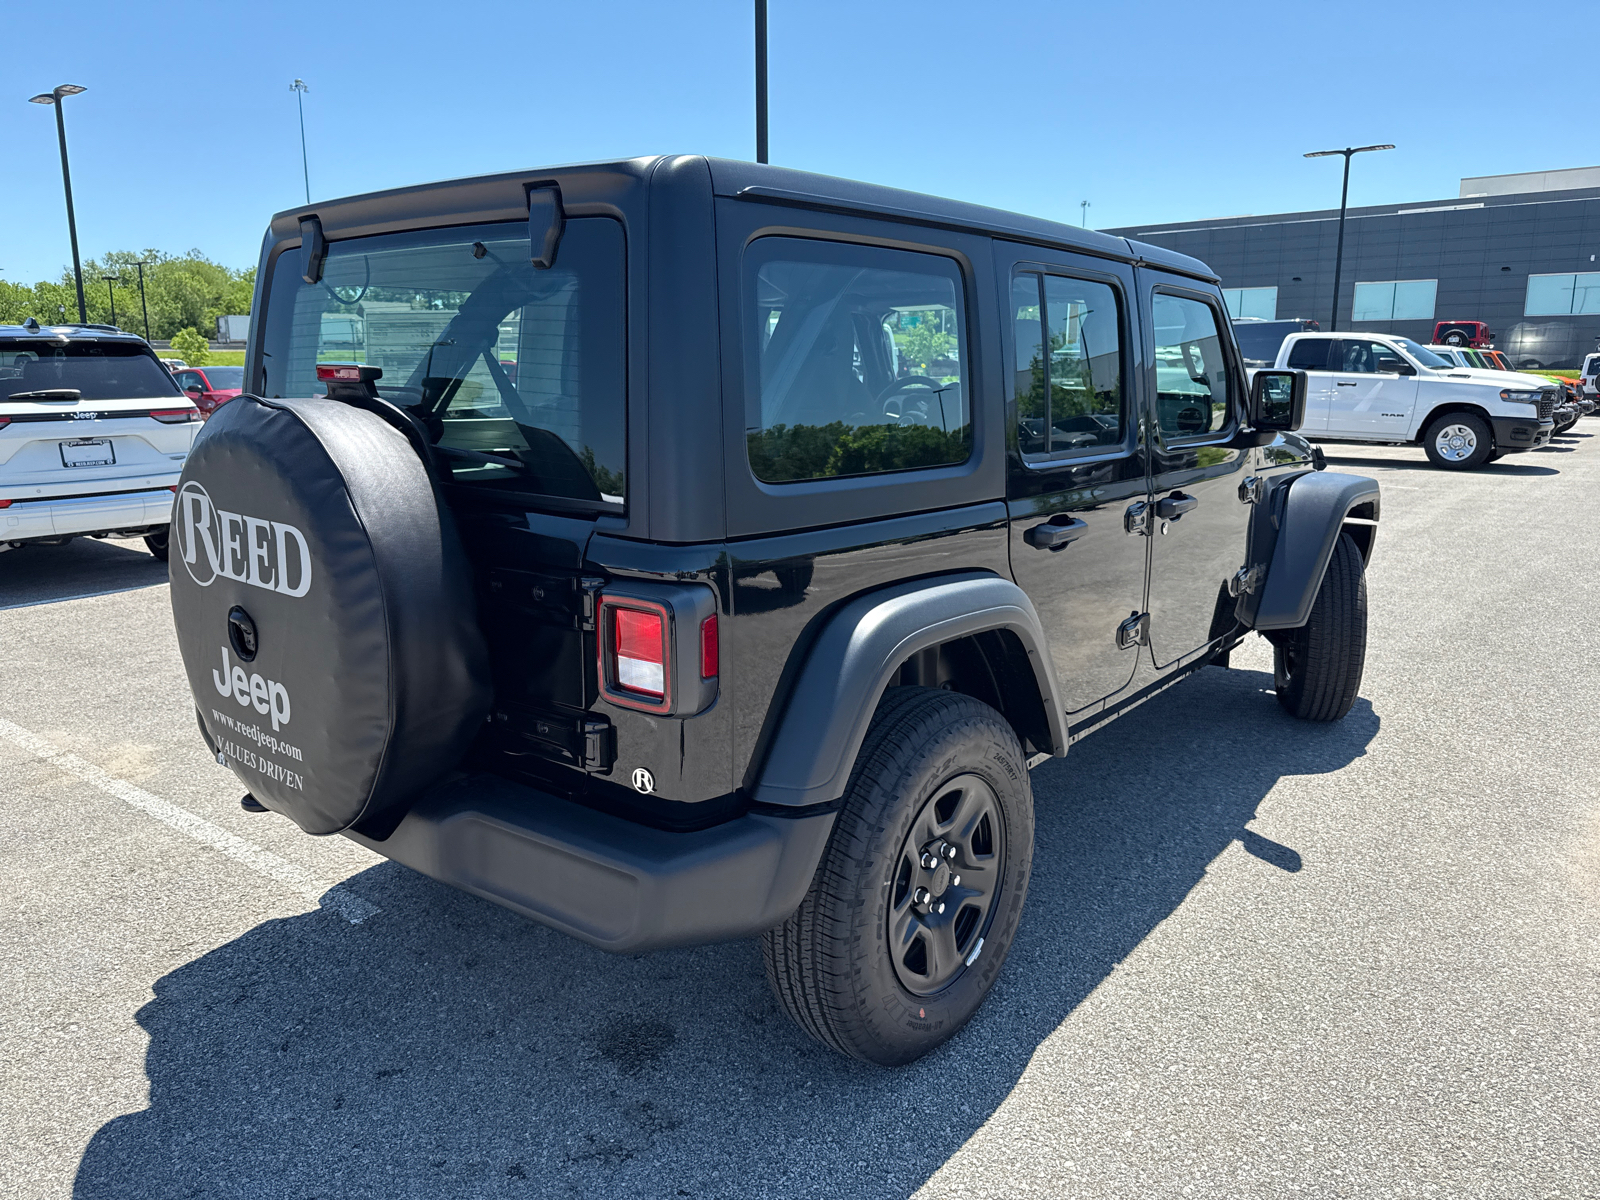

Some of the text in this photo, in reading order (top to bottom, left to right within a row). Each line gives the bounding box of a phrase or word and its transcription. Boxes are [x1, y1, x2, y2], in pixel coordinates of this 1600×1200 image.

[73, 411, 98, 420] Jeep
[177, 482, 312, 598] REED
[212, 646, 291, 732] Jeep
[211, 708, 303, 762] www.reedjeep.com
[216, 735, 303, 791] VALUES DRIVEN
[993, 752, 1018, 781] 245/75R17
[982, 870, 1026, 982] NEXEN
